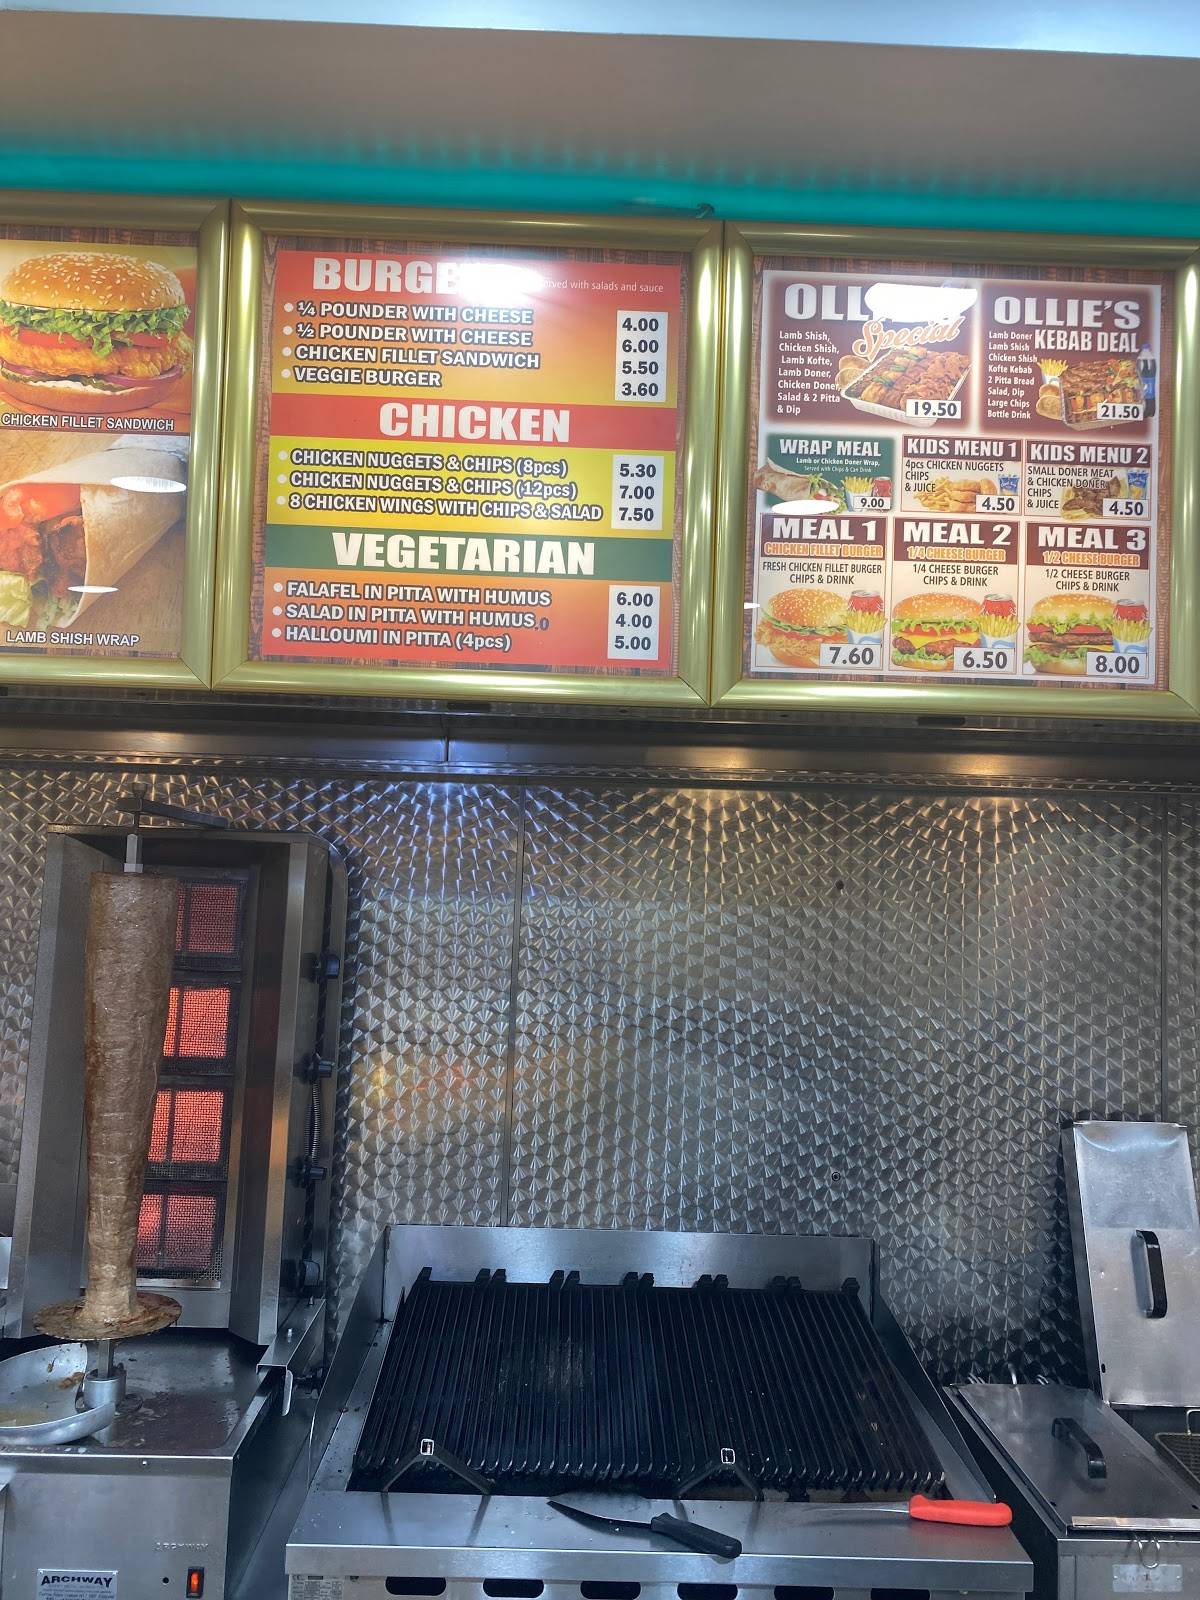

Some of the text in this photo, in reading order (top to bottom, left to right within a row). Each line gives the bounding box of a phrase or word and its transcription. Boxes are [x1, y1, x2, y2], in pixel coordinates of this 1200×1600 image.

[570, 280, 589, 289] with
[592, 281, 618, 291] salads
[621, 282, 636, 291] and
[639, 284, 664, 292] sauce
[320, 303, 533, 325] POUNDER WITH CHEESE
[994, 296, 1140, 329] OLLIE'S
[622, 318, 659, 331] 4.00
[320, 325, 532, 346] POUNDER WITH CHEESE
[779, 331, 831, 342] Lamb Shish,
[852, 316, 966, 363] Special
[989, 331, 1032, 340] Lamb Doner
[1035, 329, 1140, 353] KEBAB DEAL
[622, 339, 659, 353] 6.00
[779, 343, 839, 355] Chicken Shish,
[988, 342, 1030, 351] Lamb Shish
[295, 346, 540, 368] CHICKEN FILLET SANDWICH
[782, 355, 832, 366] Lamb Kofte,
[988, 354, 1037, 363] Chicken Shish
[622, 361, 659, 375] 5.50
[778, 368, 831, 379] Lamb Doner,
[988, 365, 1032, 374] Kofte Kebab
[294, 367, 441, 386] VEGGIE BURGER
[995, 376, 1012, 384] Pitta
[1014, 377, 1034, 385] Bread
[621, 382, 658, 396] 3.60
[778, 380, 811, 389] Chicken
[778, 392, 840, 403] Salad & 2 Pitta
[988, 387, 1024, 397] Salad, Dip
[914, 401, 957, 416] 19.50
[987, 399, 1030, 409] Large Chips
[987, 410, 1030, 419] Bottle Drink
[1101, 405, 1140, 418] 21.50
[2, 413, 174, 431] CHICKEN FILLET SANDWICH
[379, 402, 570, 442] CHICKEN
[779, 439, 881, 456] WRAP MEAL
[907, 438, 1016, 457] KIDS MENU 1
[1030, 444, 1148, 464] KIDS MENU 2
[291, 449, 567, 477] CHICKEN NUGGETS & CHIPS (8pcs)
[620, 463, 656, 477] 5.30
[905, 460, 1004, 471] 4pcs CHICKEN NUGGETS
[906, 471, 929, 480] CHIPS
[1028, 466, 1114, 477] SMALL DONER MEAT
[291, 472, 577, 499] CHICKEN NUGGETS & CHIPS (12pcs)
[620, 485, 655, 499] 7.00
[1028, 488, 1051, 497] CHIPS
[289, 494, 602, 520] 8 CHICKEN WINGS WITH CHIPS & SALAD
[861, 498, 884, 508] 9.00
[981, 497, 1015, 511] 4.50
[1109, 501, 1143, 515] 4.50
[619, 508, 654, 522] 7.50
[773, 517, 876, 541] MEAL 1
[903, 522, 1011, 545] MEAL 2
[1038, 526, 1146, 550] MEAL 3
[332, 532, 595, 575] VEGETARIAN
[763, 562, 881, 573] FRESH CHICKEN FILLET BURGER
[913, 564, 998, 575] 1/4 CHEESE BURGER
[790, 574, 854, 584] CHIPS DRINK
[923, 576, 988, 586] CHIPS DRINK
[1046, 569, 1129, 581] 1/2 CHEESE BURGER
[286, 581, 551, 606] FALAFEL IN PITTA WITH HUMUS
[1056, 581, 1119, 592] CHIPS DRINK
[617, 592, 653, 606] 6.00
[286, 605, 535, 627] SALAD IN PITTA WITH HUMUS
[616, 614, 652, 628] 4.00
[6, 631, 140, 646] LAMB SHISH WRAP
[286, 627, 511, 652] HALLOUMI IN PITTA (4pcs)
[615, 636, 651, 650] 5.00
[829, 647, 874, 665] 7.60
[963, 651, 1008, 669] 6.50
[1095, 656, 1140, 674] 8.00
[41, 1575, 113, 1588] ARCHWAY
